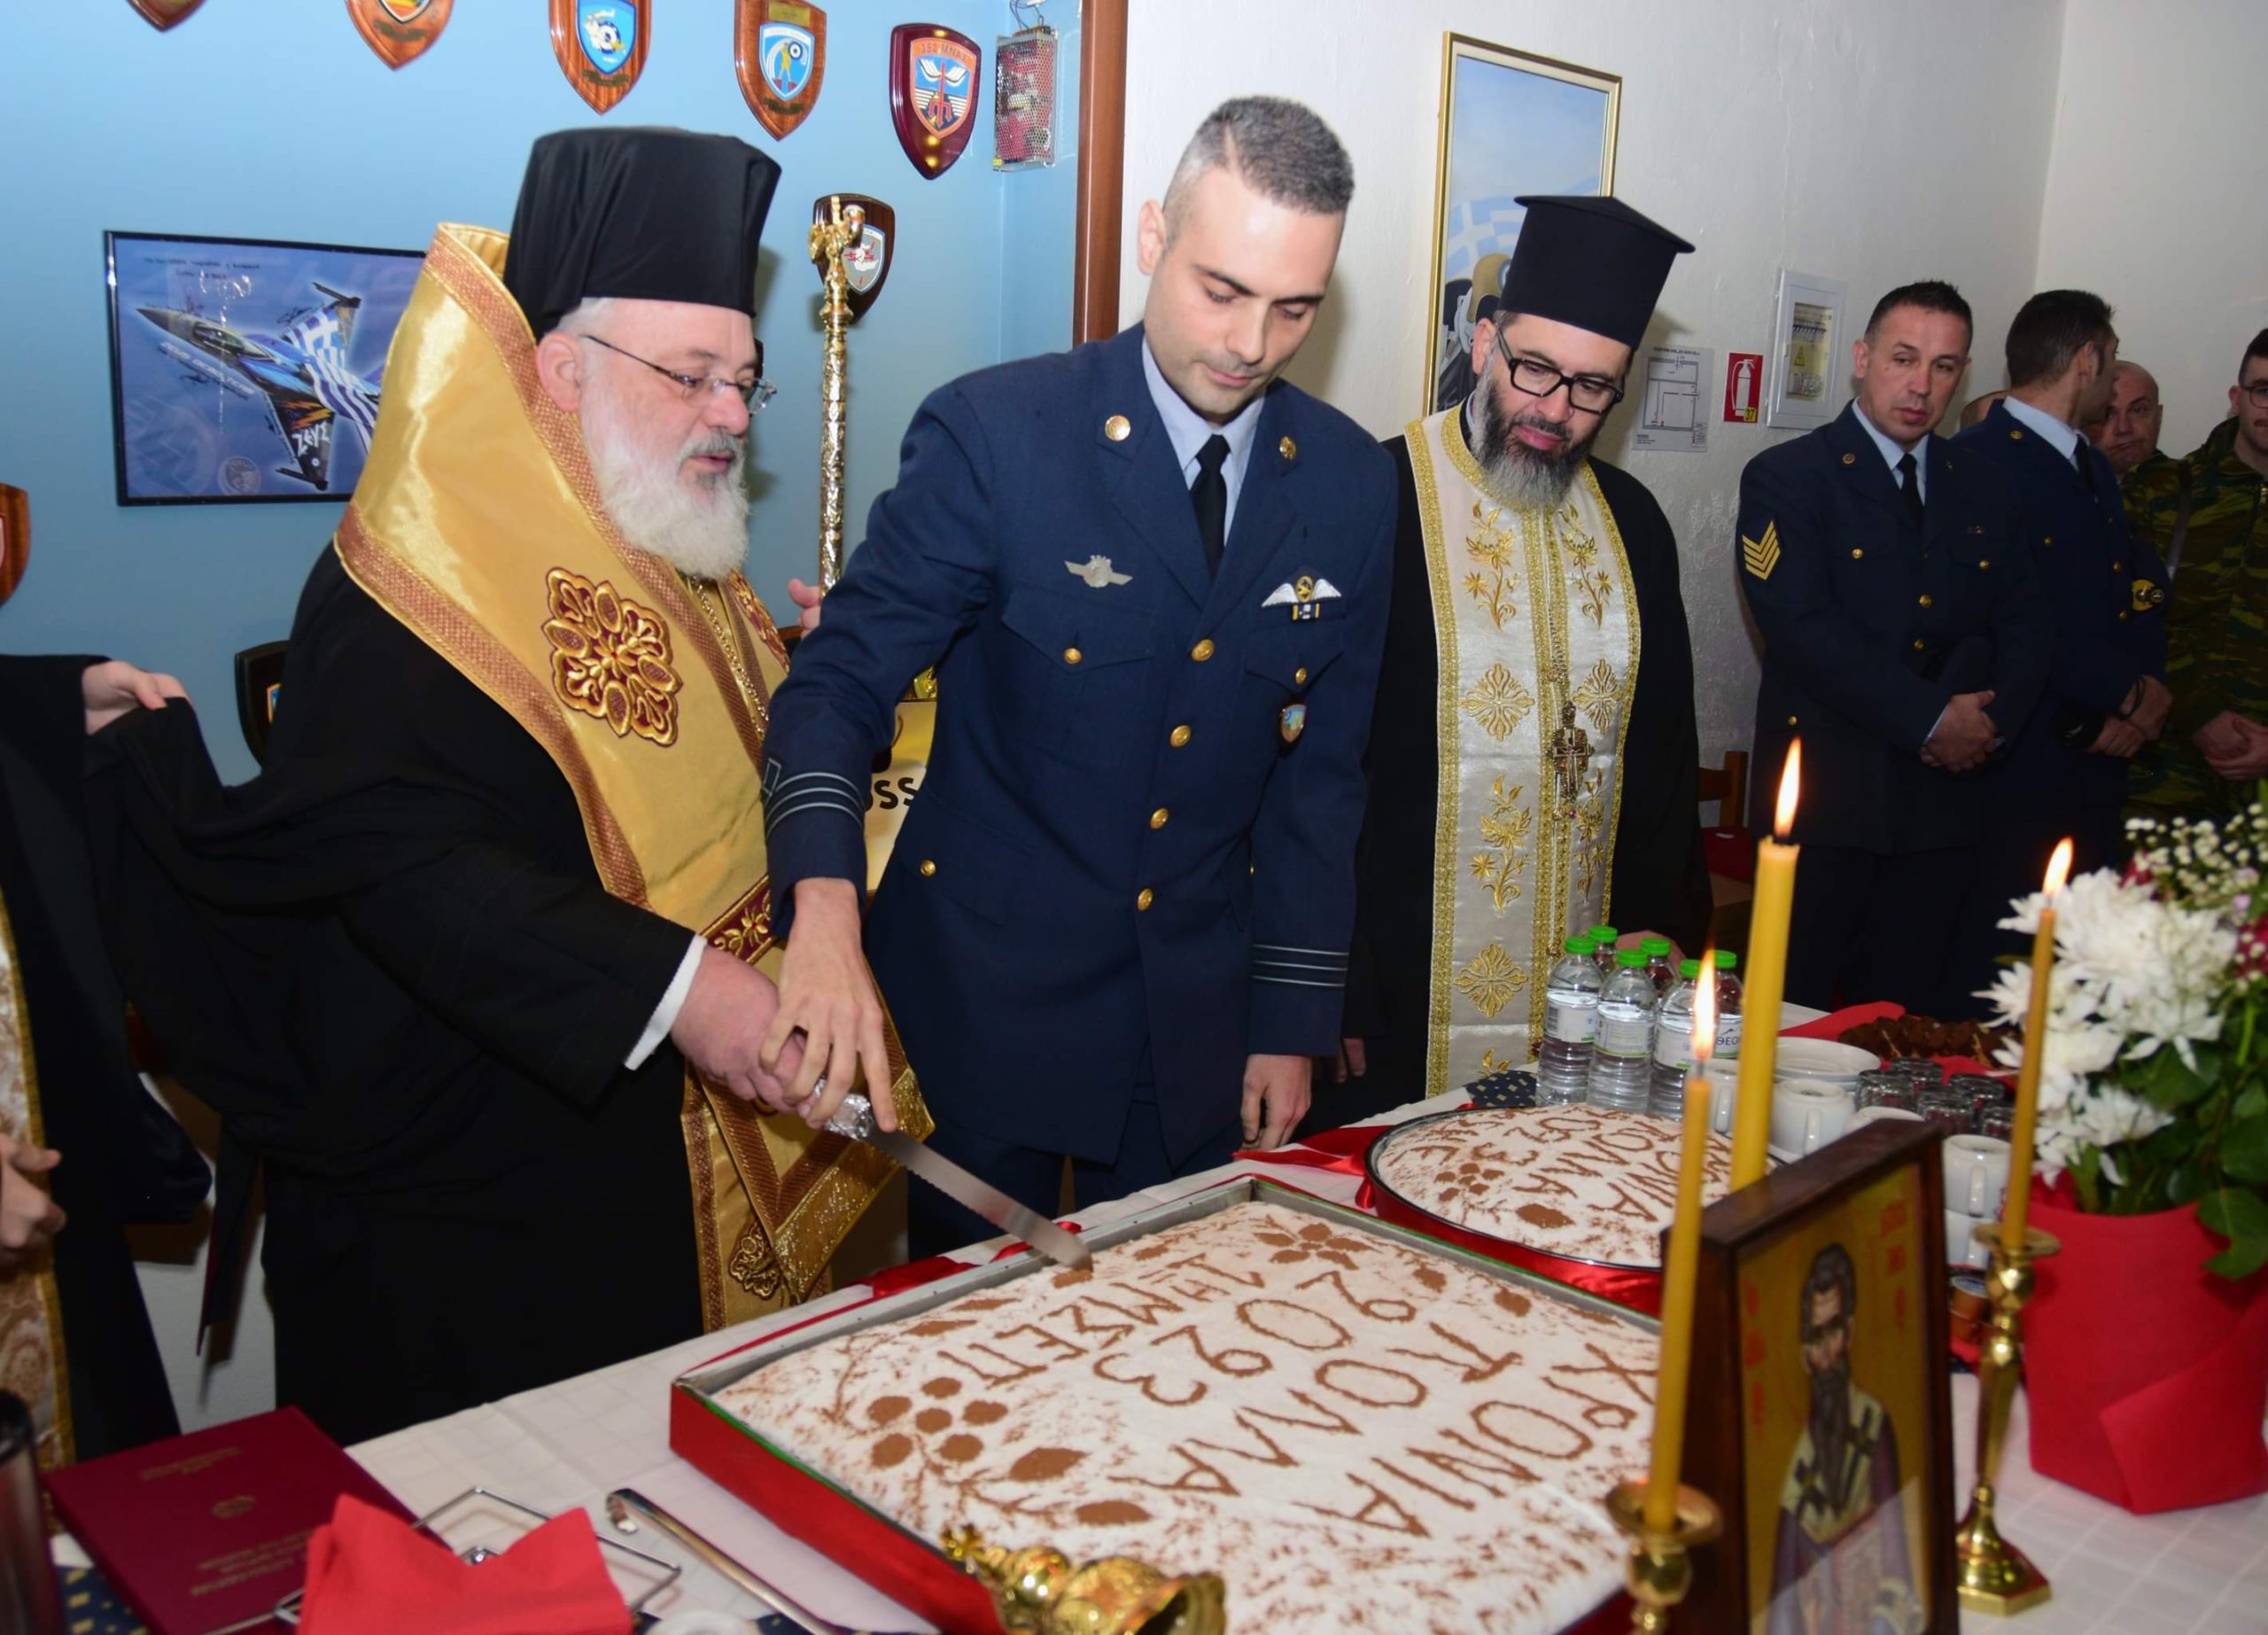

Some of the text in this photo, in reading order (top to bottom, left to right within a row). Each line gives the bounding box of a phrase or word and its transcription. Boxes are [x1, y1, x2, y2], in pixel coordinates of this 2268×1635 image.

[1745, 409, 1755, 420] 37
[866, 776, 919, 810] SS
[1092, 1270, 1416, 1407] 2023
